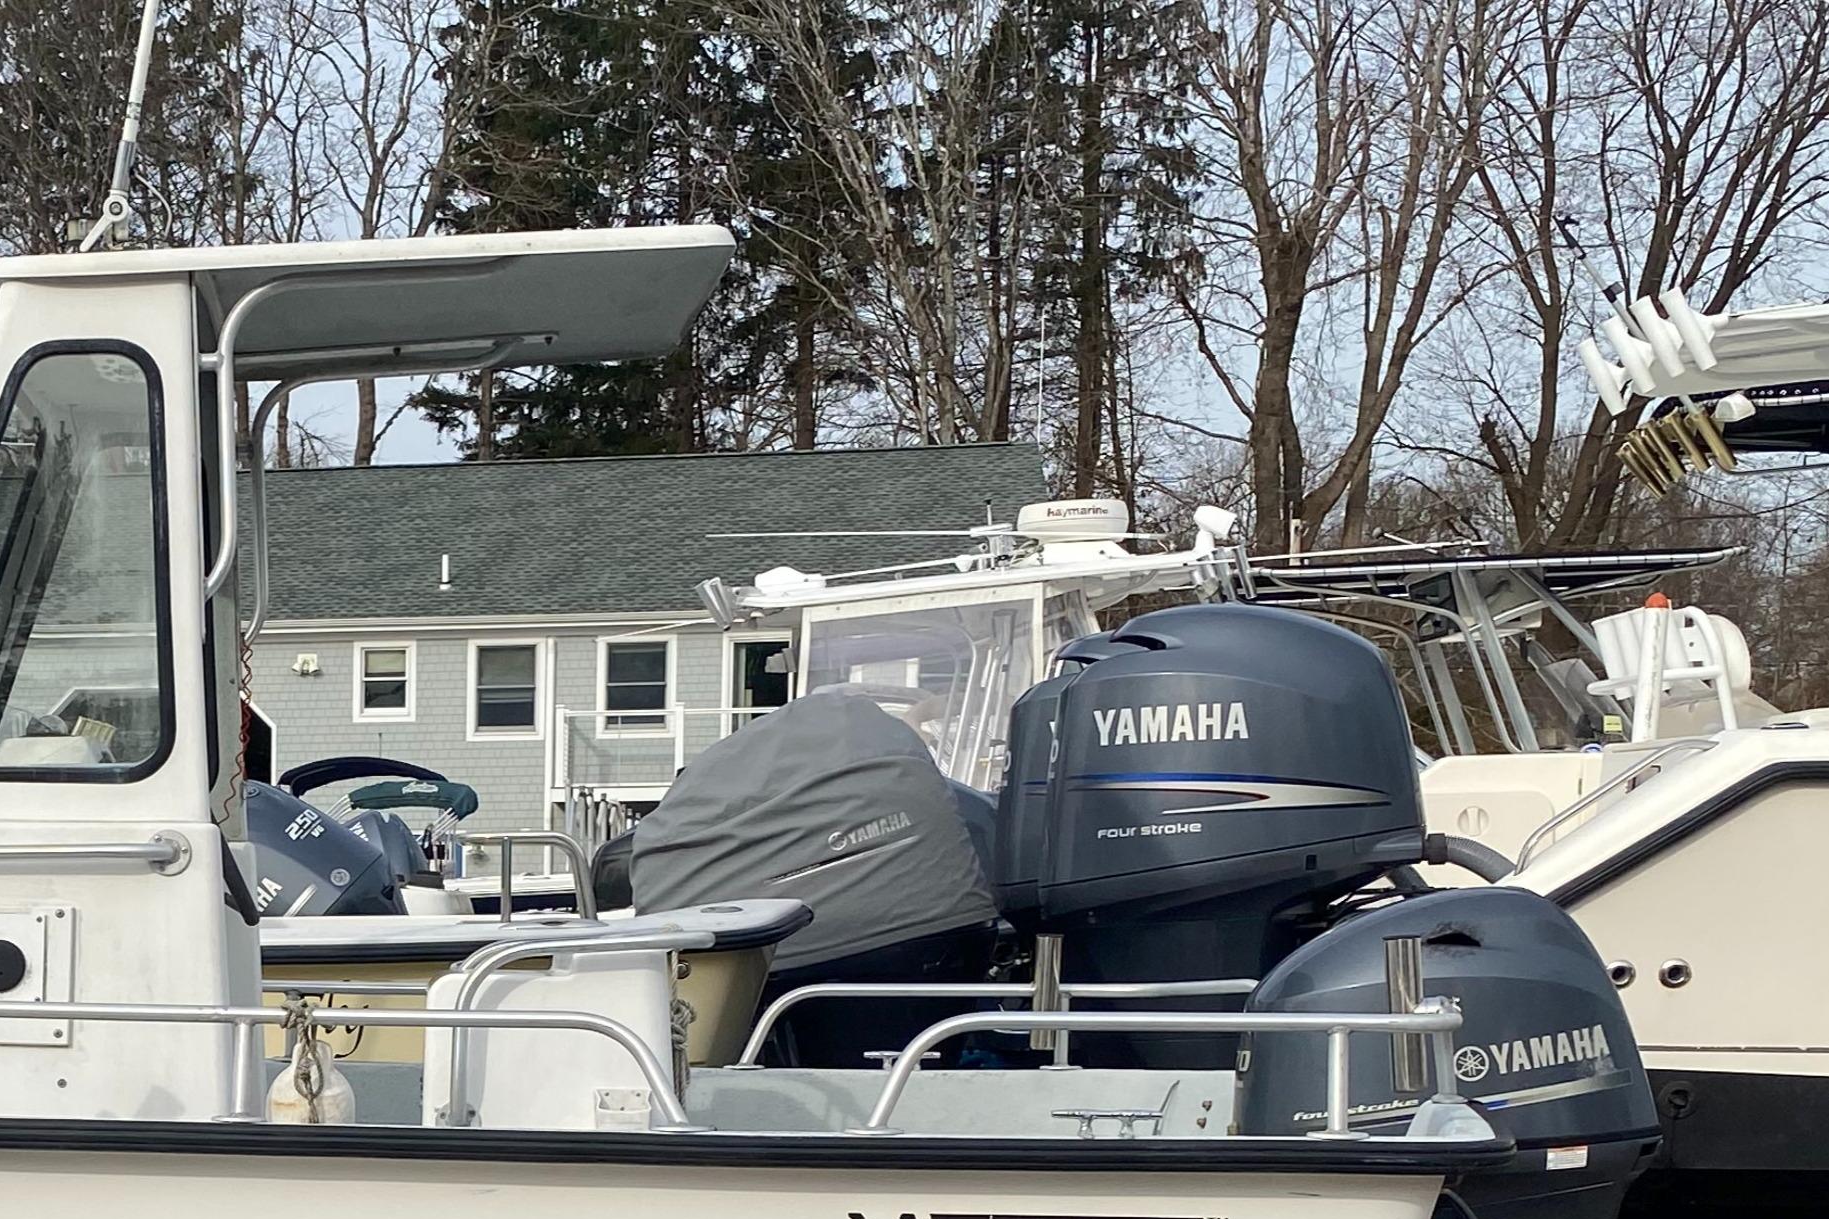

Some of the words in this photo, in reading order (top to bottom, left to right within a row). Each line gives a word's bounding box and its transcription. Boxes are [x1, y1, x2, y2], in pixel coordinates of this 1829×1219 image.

[1093, 702, 1249, 747] YAMAHA
[285, 809, 319, 841] 250
[847, 811, 912, 845] YAMAHA
[257, 877, 284, 912] HA
[1488, 1023, 1610, 1075] YAMAHA
